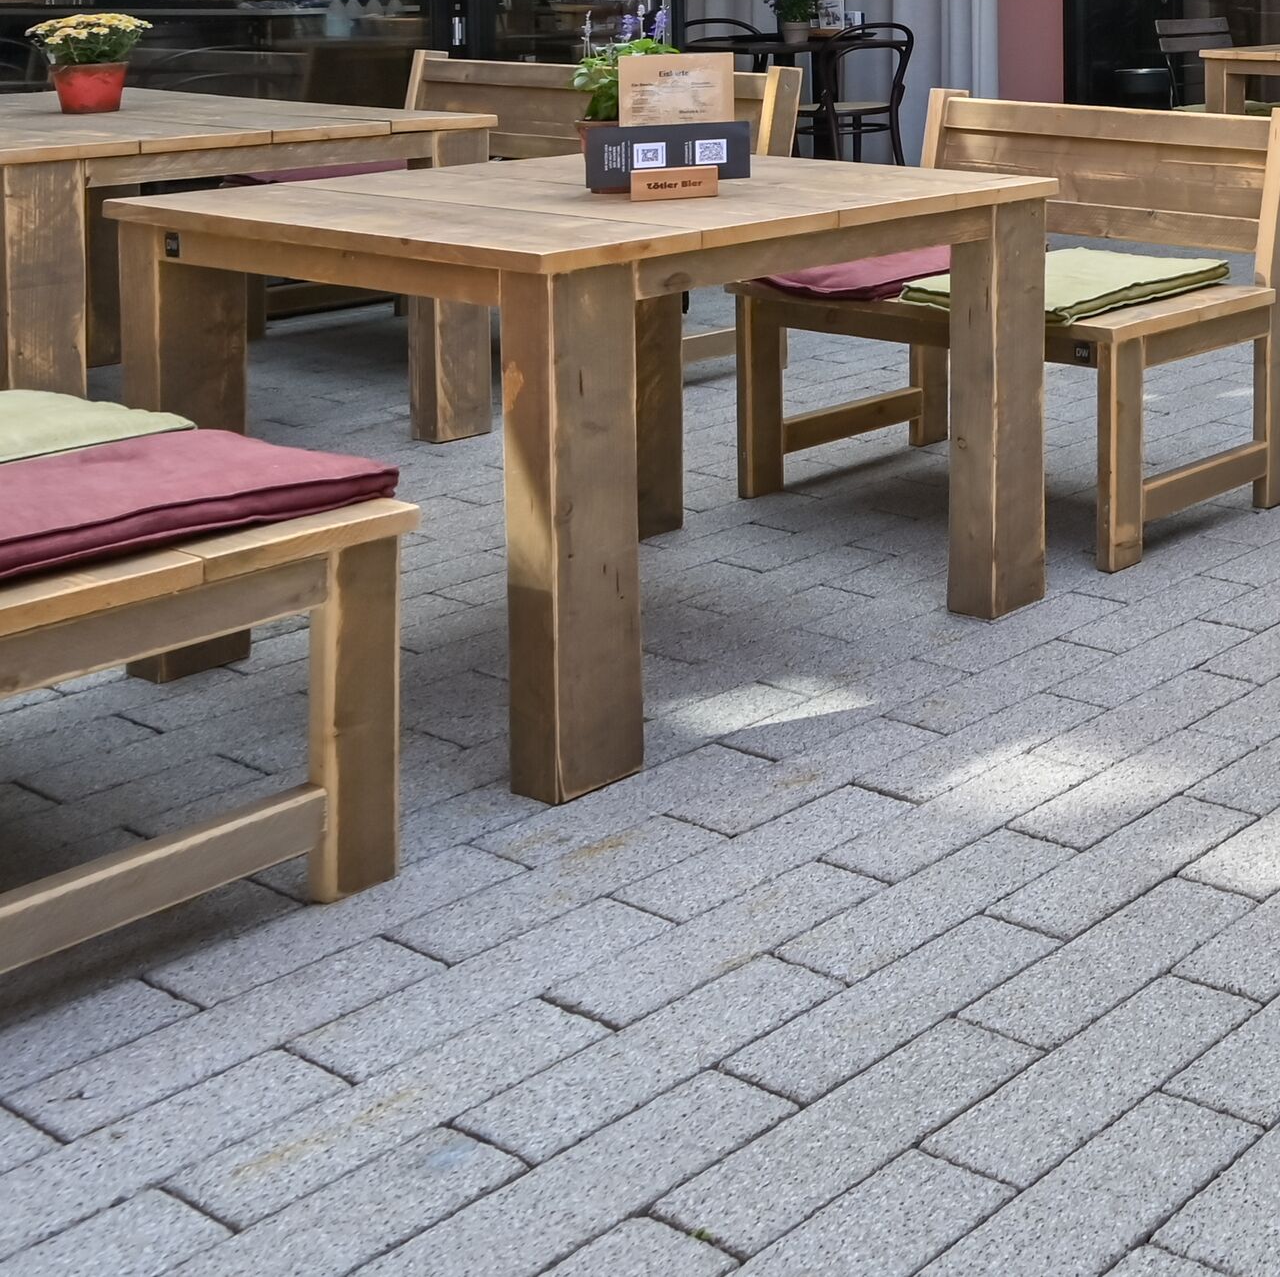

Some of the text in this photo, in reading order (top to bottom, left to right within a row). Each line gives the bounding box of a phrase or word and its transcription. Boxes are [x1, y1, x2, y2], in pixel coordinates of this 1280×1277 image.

[658, 70, 690, 78] Eisrte
[681, 179, 703, 188] Bier
[1075, 347, 1089, 357] DW
